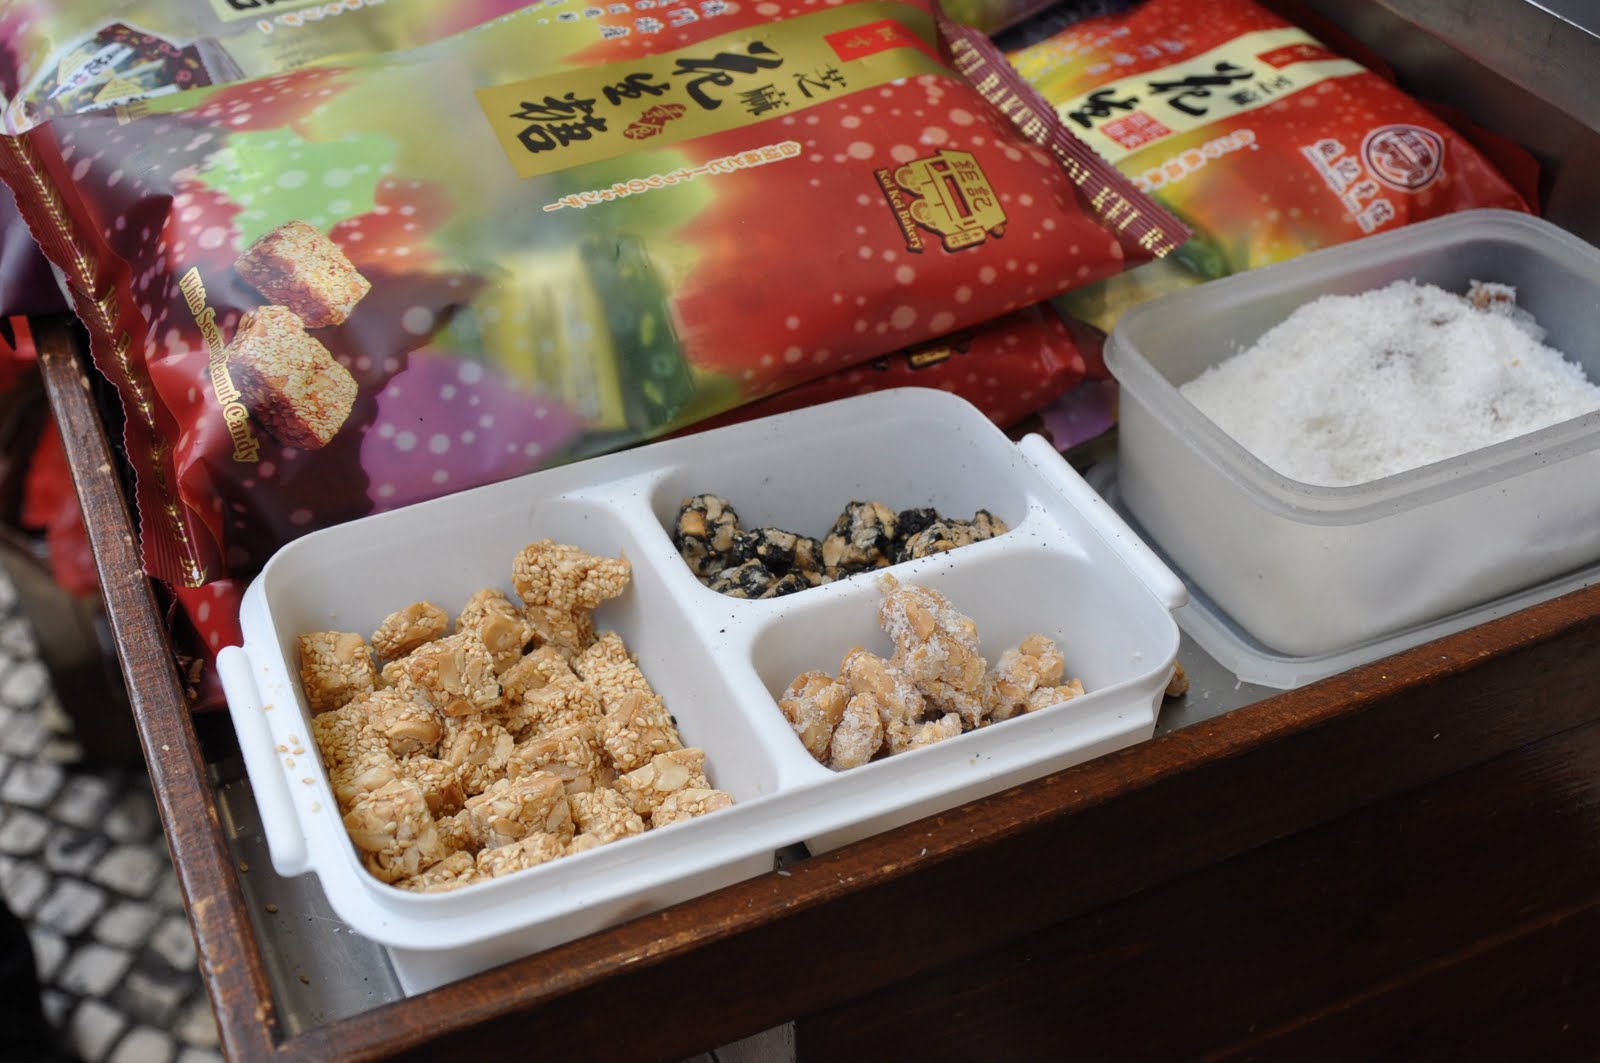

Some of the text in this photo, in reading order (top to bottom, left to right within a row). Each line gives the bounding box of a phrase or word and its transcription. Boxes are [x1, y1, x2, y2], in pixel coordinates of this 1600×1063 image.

[508, 40, 784, 154] 花生糖
[735, 63, 848, 118] 芝麻
[877, 167, 924, 250] Koi Kei Bakery
[950, 158, 993, 213] 鉅記
[179, 268, 259, 462] White Sesame Peanut Candy
